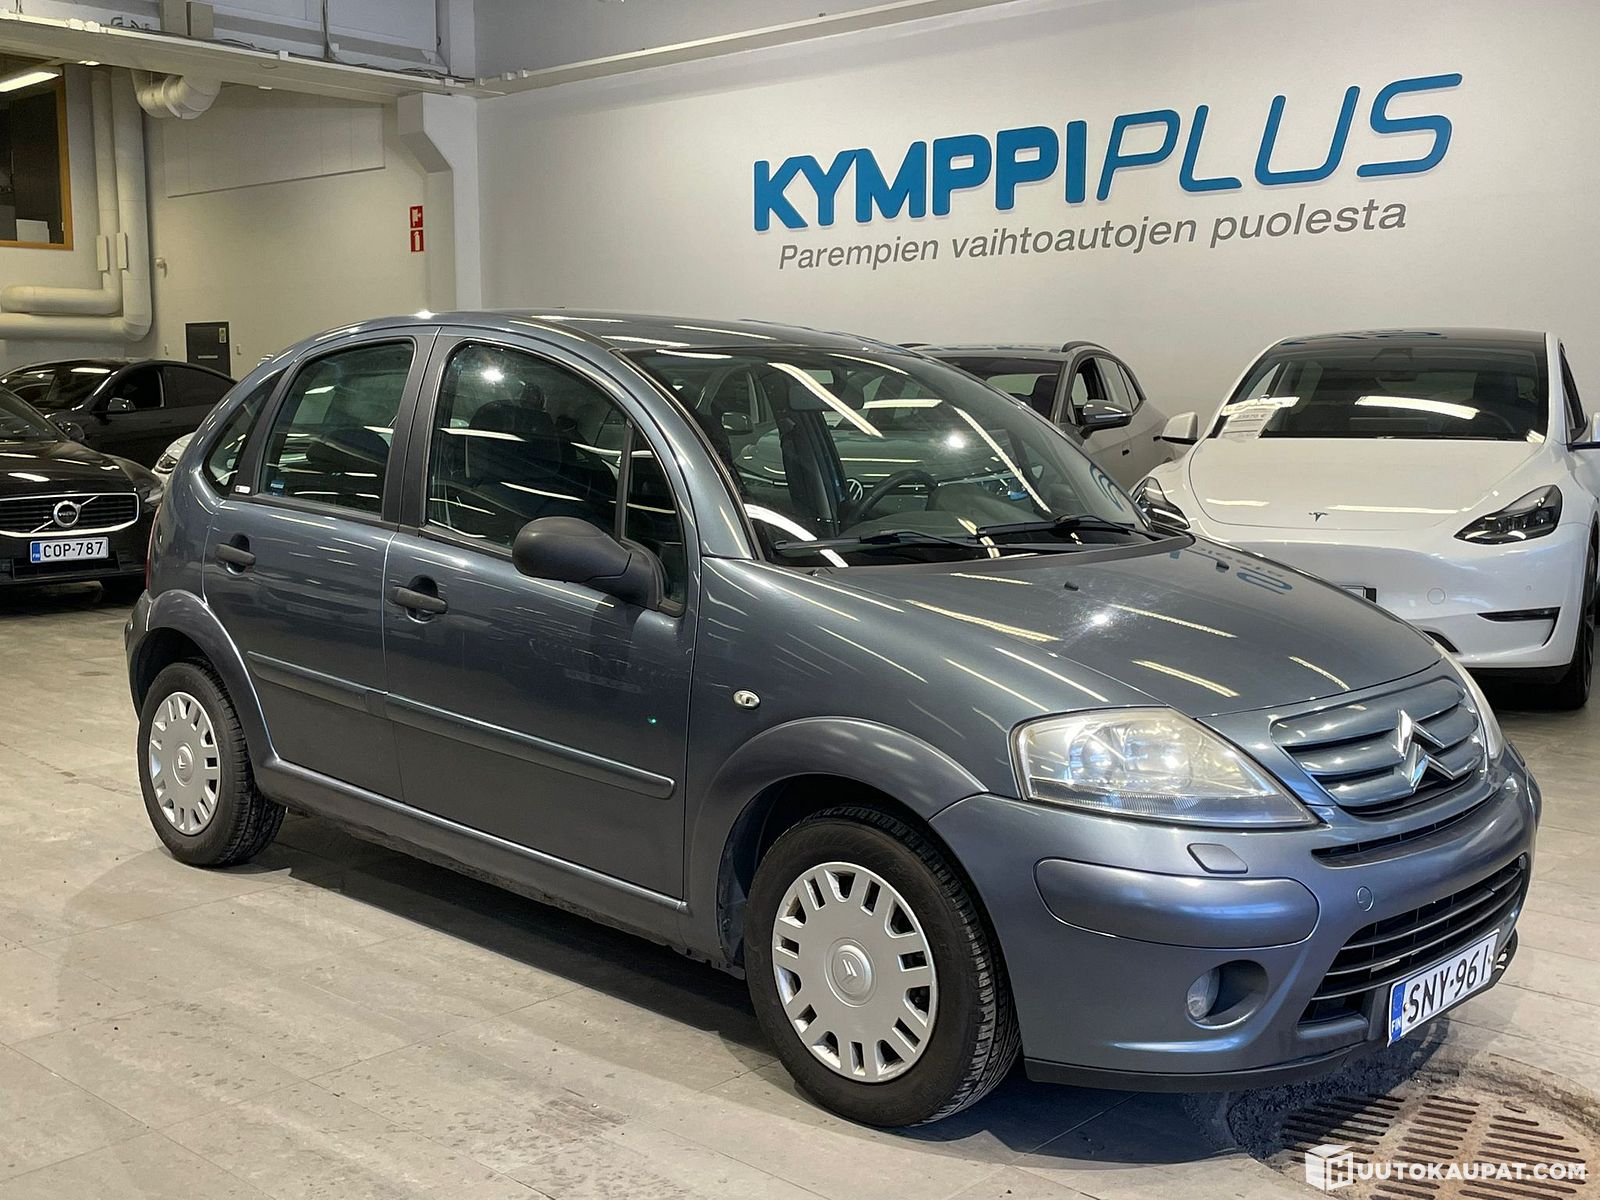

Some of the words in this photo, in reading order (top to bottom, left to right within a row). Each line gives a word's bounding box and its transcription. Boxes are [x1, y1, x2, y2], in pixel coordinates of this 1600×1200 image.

[754, 73, 1462, 232] KYMPPIPLUS
[779, 236, 939, 271] Parempien
[952, 215, 1197, 259] vaihtoautojen
[1210, 198, 1407, 249] puolesta
[43, 541, 104, 558] COP-787
[1407, 943, 1490, 1024] SNY-961
